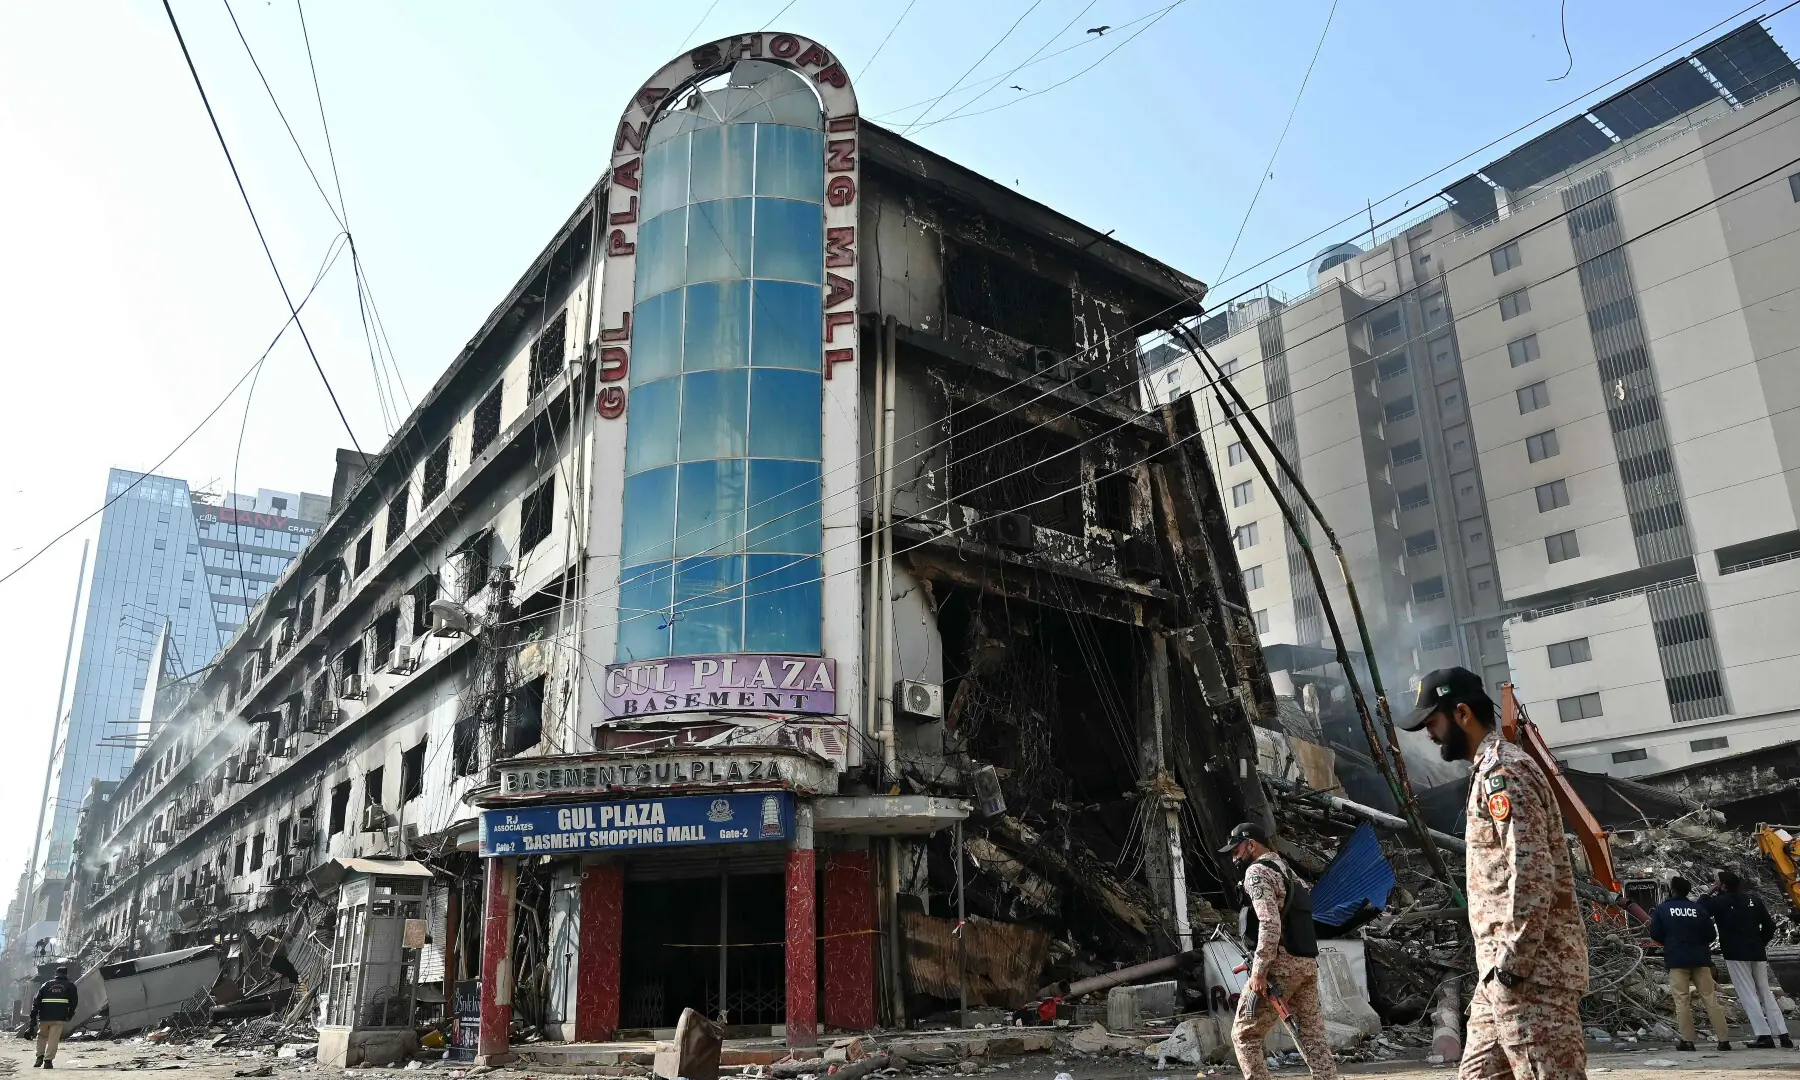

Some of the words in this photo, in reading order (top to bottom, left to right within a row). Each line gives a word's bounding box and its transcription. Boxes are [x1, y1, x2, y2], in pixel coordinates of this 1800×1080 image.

[691, 33, 857, 207] SHOPPING
[609, 86, 670, 258] PLAZA
[825, 226, 854, 381] MALL
[596, 311, 630, 419] GUL
[606, 662, 677, 698] GUL
[690, 658, 836, 693] PLAZA
[623, 691, 810, 715] BASEMENT
[690, 759, 783, 781] PLAZA
[493, 823, 534, 832] ASSOCIATES
[557, 807, 597, 831] GUL
[600, 802, 666, 828] PLAZA
[589, 827, 664, 847] SHOPPING
[666, 825, 706, 843] MALL
[720, 828, 749, 839] Gate-2
[1669, 907, 1698, 918] POLICE
